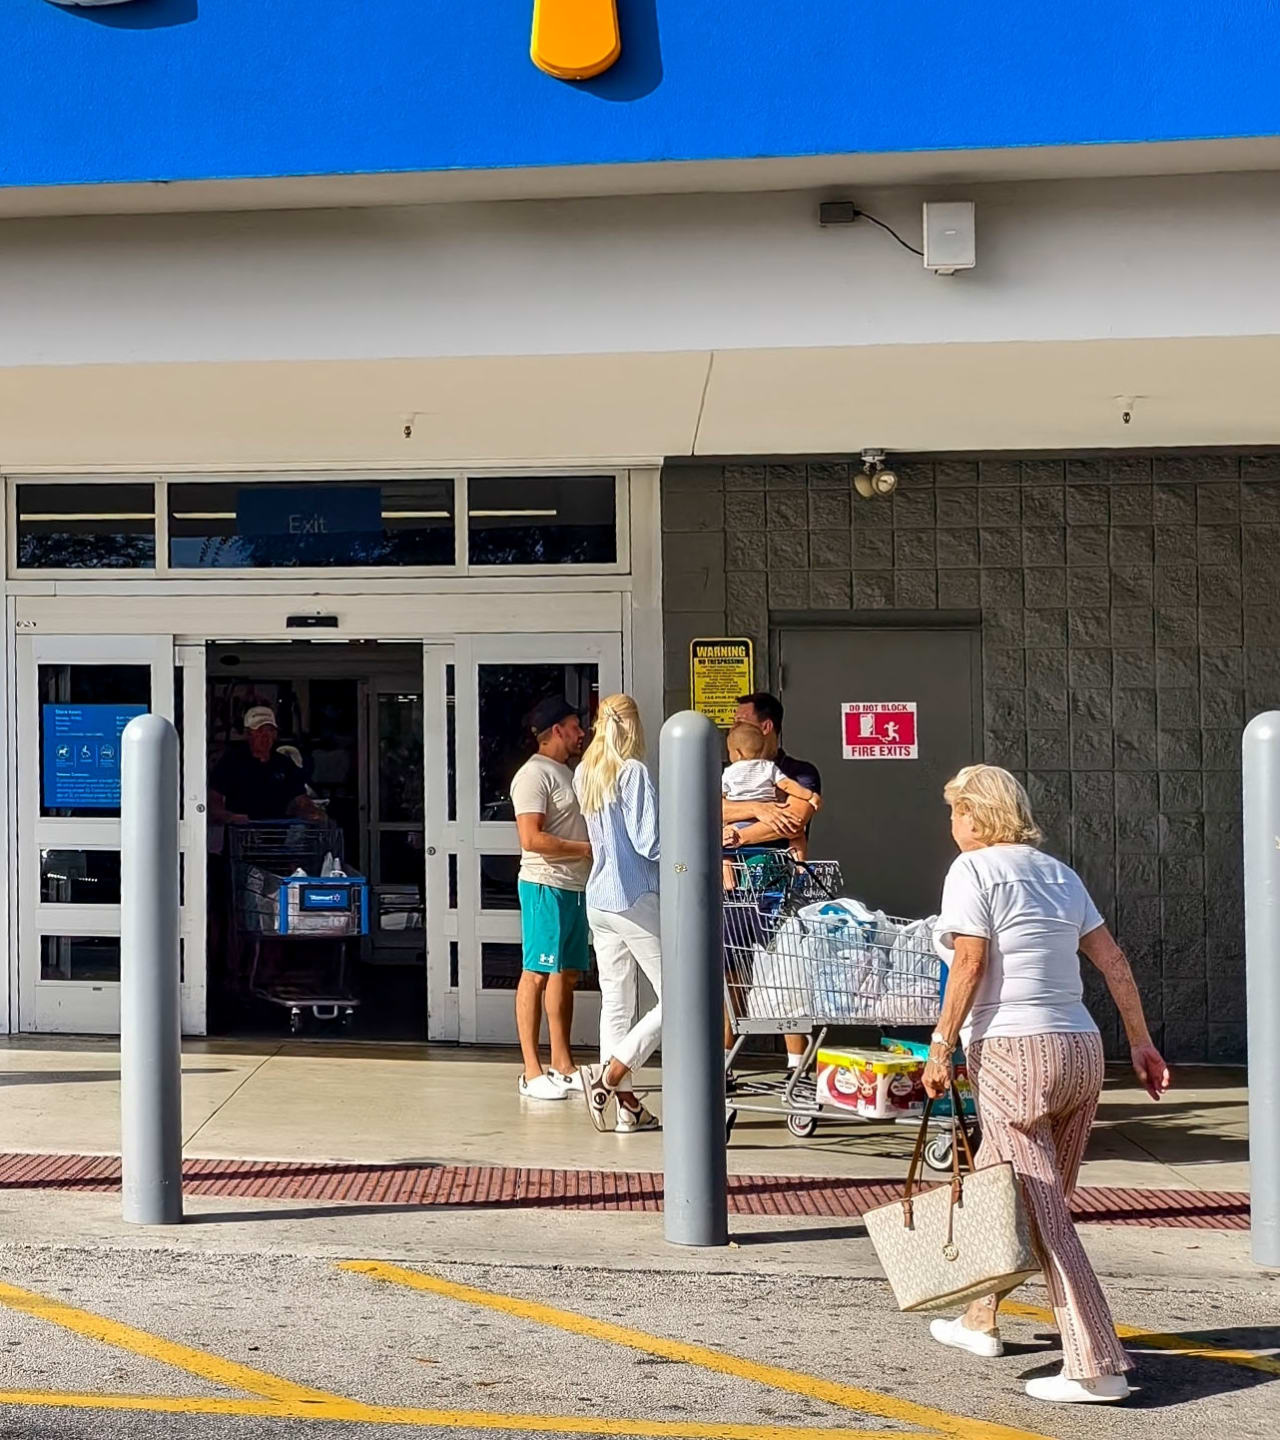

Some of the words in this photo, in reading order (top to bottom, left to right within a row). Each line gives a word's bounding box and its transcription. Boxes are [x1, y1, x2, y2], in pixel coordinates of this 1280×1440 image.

[289, 513, 328, 534] Exit
[696, 646, 746, 657] WARNING
[849, 704, 860, 712] DO
[852, 746, 876, 757] FIRE
[880, 746, 911, 757] EXITS
